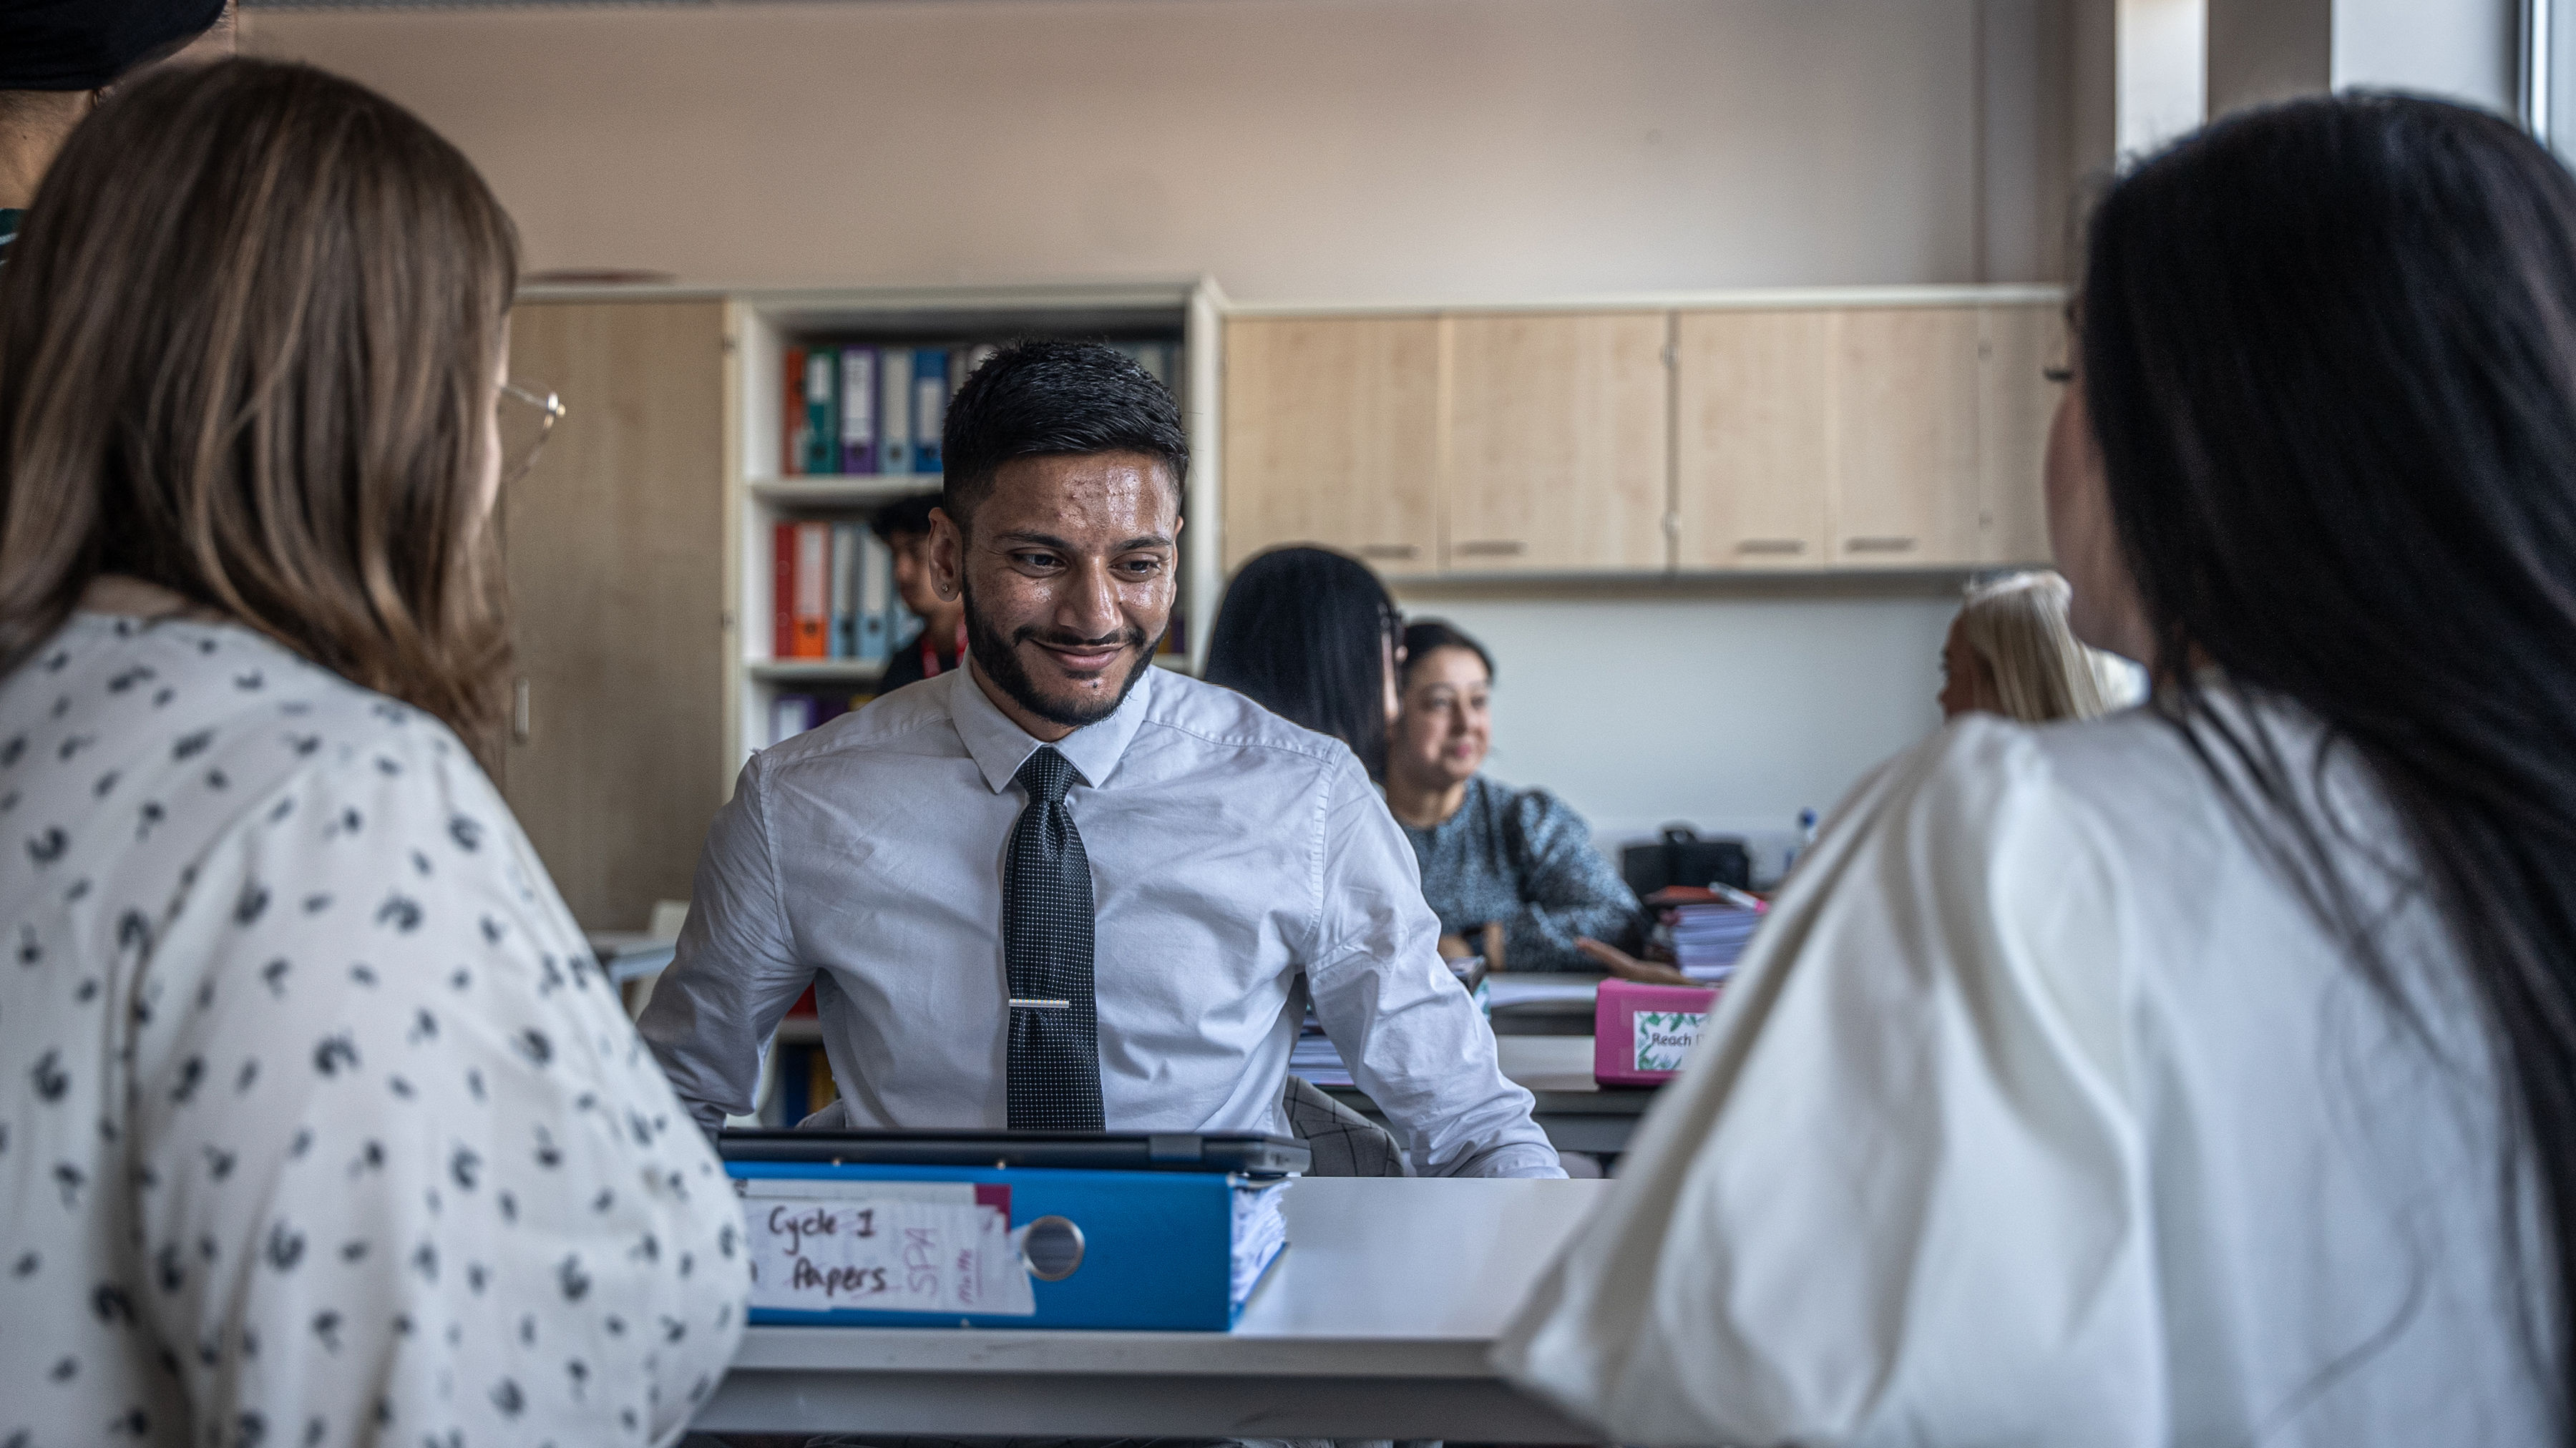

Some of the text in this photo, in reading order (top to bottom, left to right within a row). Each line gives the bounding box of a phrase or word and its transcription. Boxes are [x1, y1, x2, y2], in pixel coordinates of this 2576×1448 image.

[1652, 1032, 1692, 1047] Reach
[769, 1205, 839, 1256] Cycle
[793, 1256, 887, 1298] Papers
